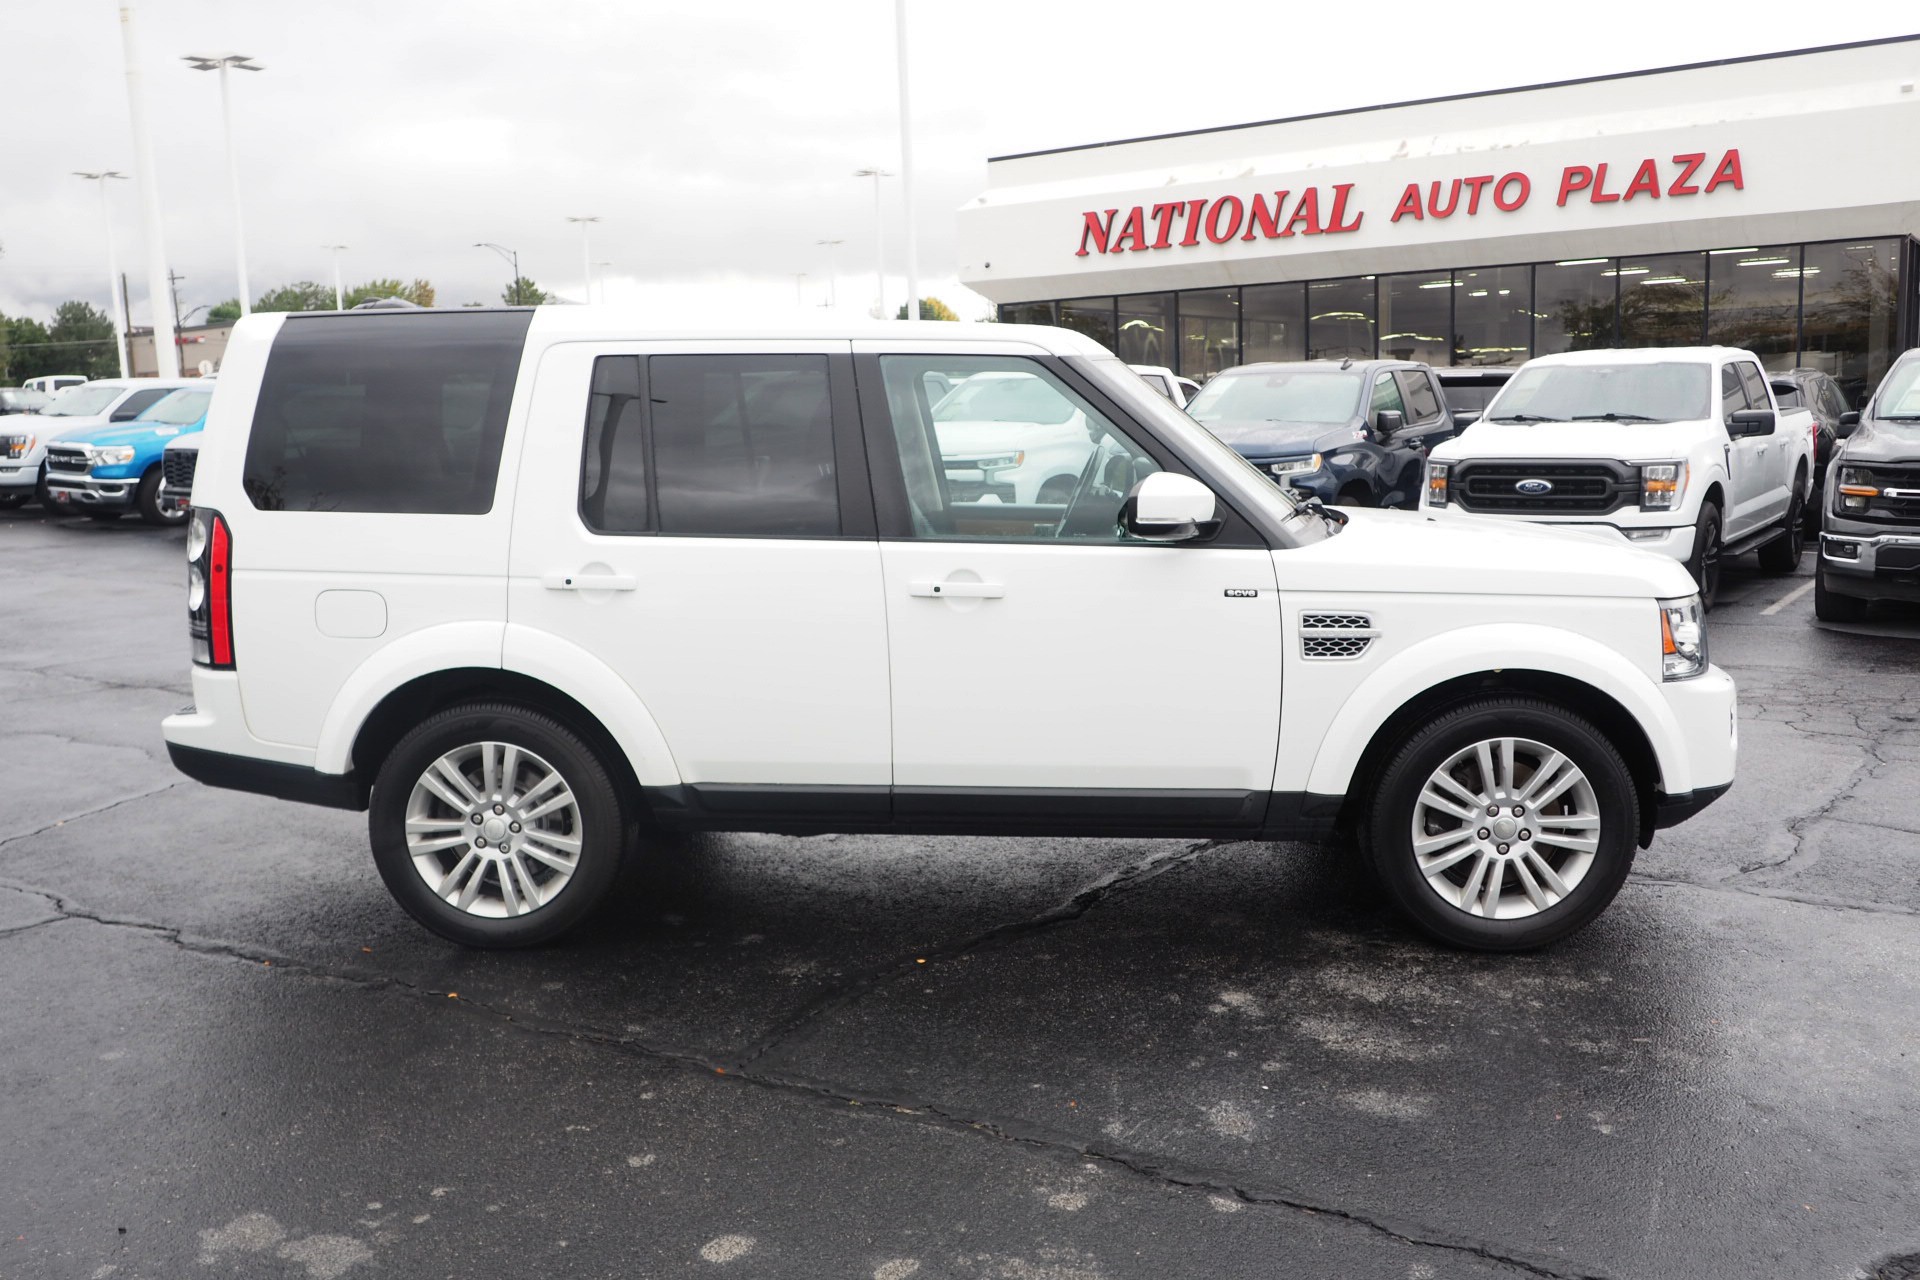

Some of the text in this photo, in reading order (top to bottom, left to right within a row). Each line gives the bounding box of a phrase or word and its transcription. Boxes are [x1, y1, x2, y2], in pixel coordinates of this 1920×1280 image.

[1077, 148, 1745, 257] NATIONAL AUTO PLAZA
